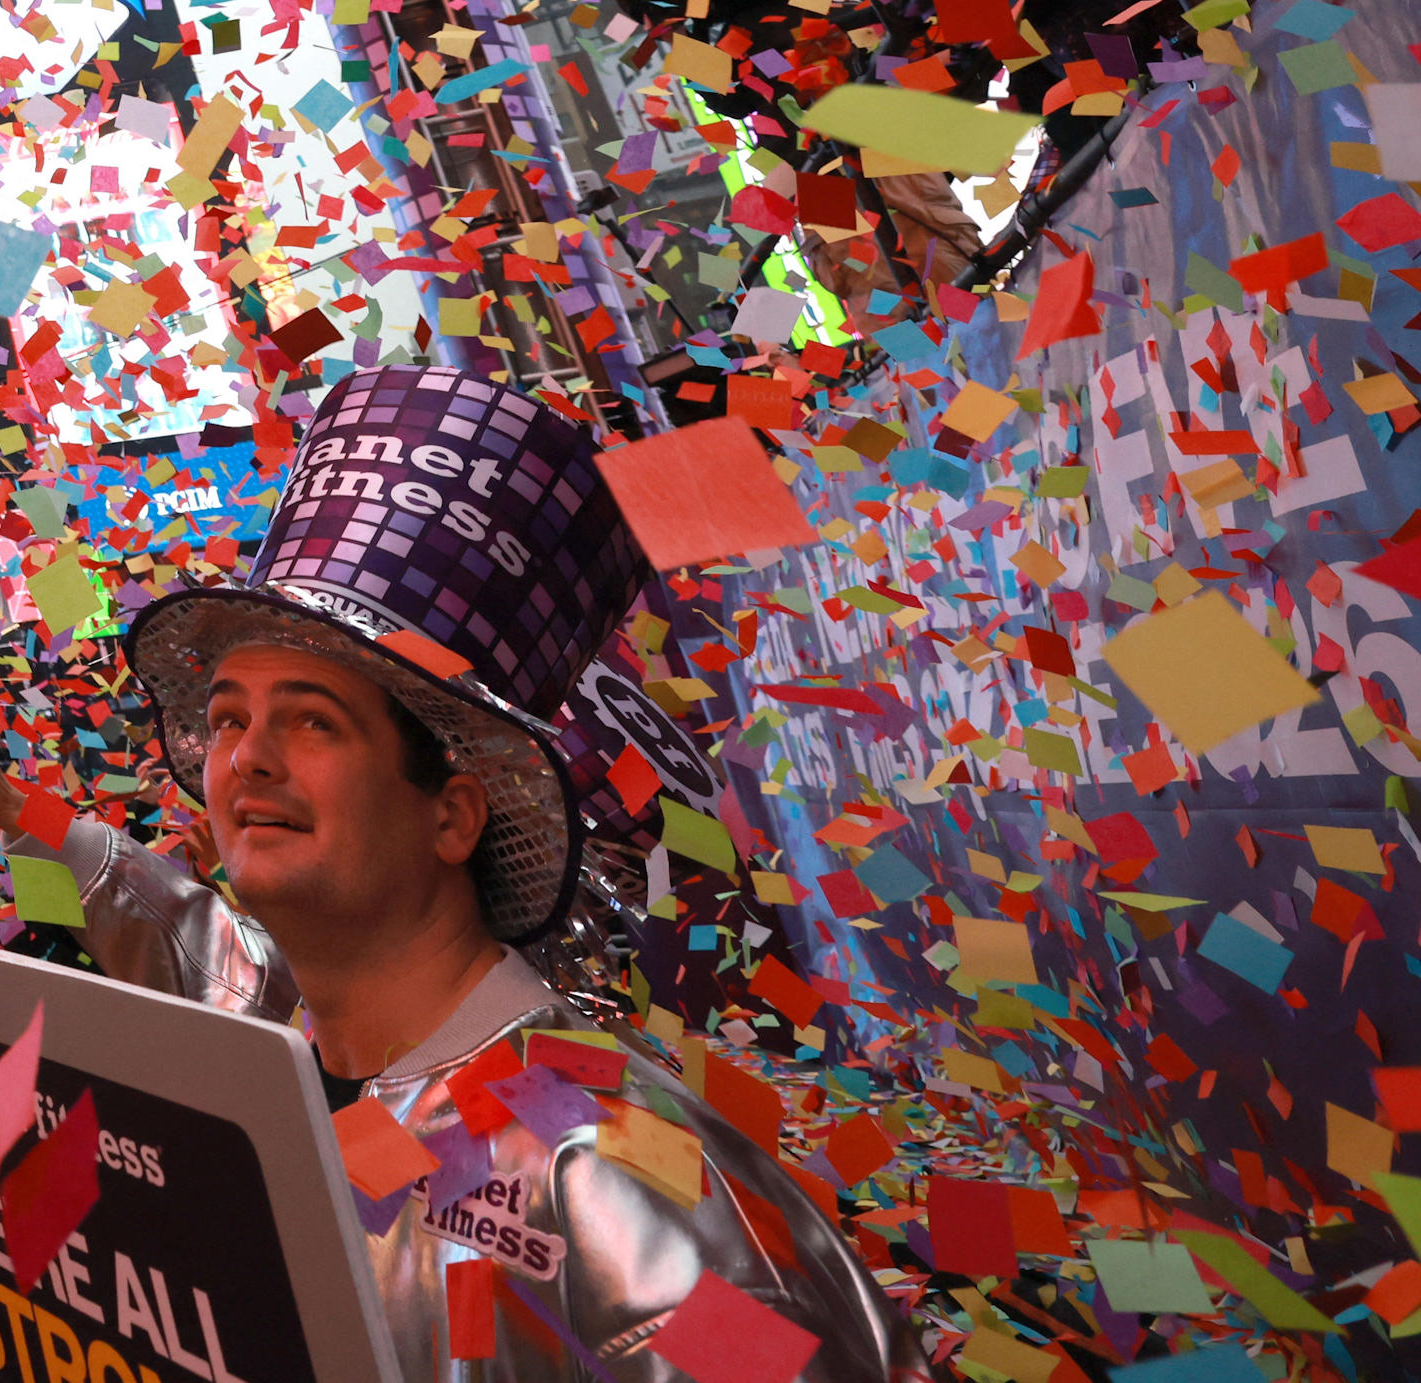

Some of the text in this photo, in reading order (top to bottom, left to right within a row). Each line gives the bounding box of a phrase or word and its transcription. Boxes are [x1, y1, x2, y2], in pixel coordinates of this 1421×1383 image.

[285, 464, 532, 577] itness
[34, 1090, 165, 1187] fiess
[114, 1251, 248, 1383] ALL
